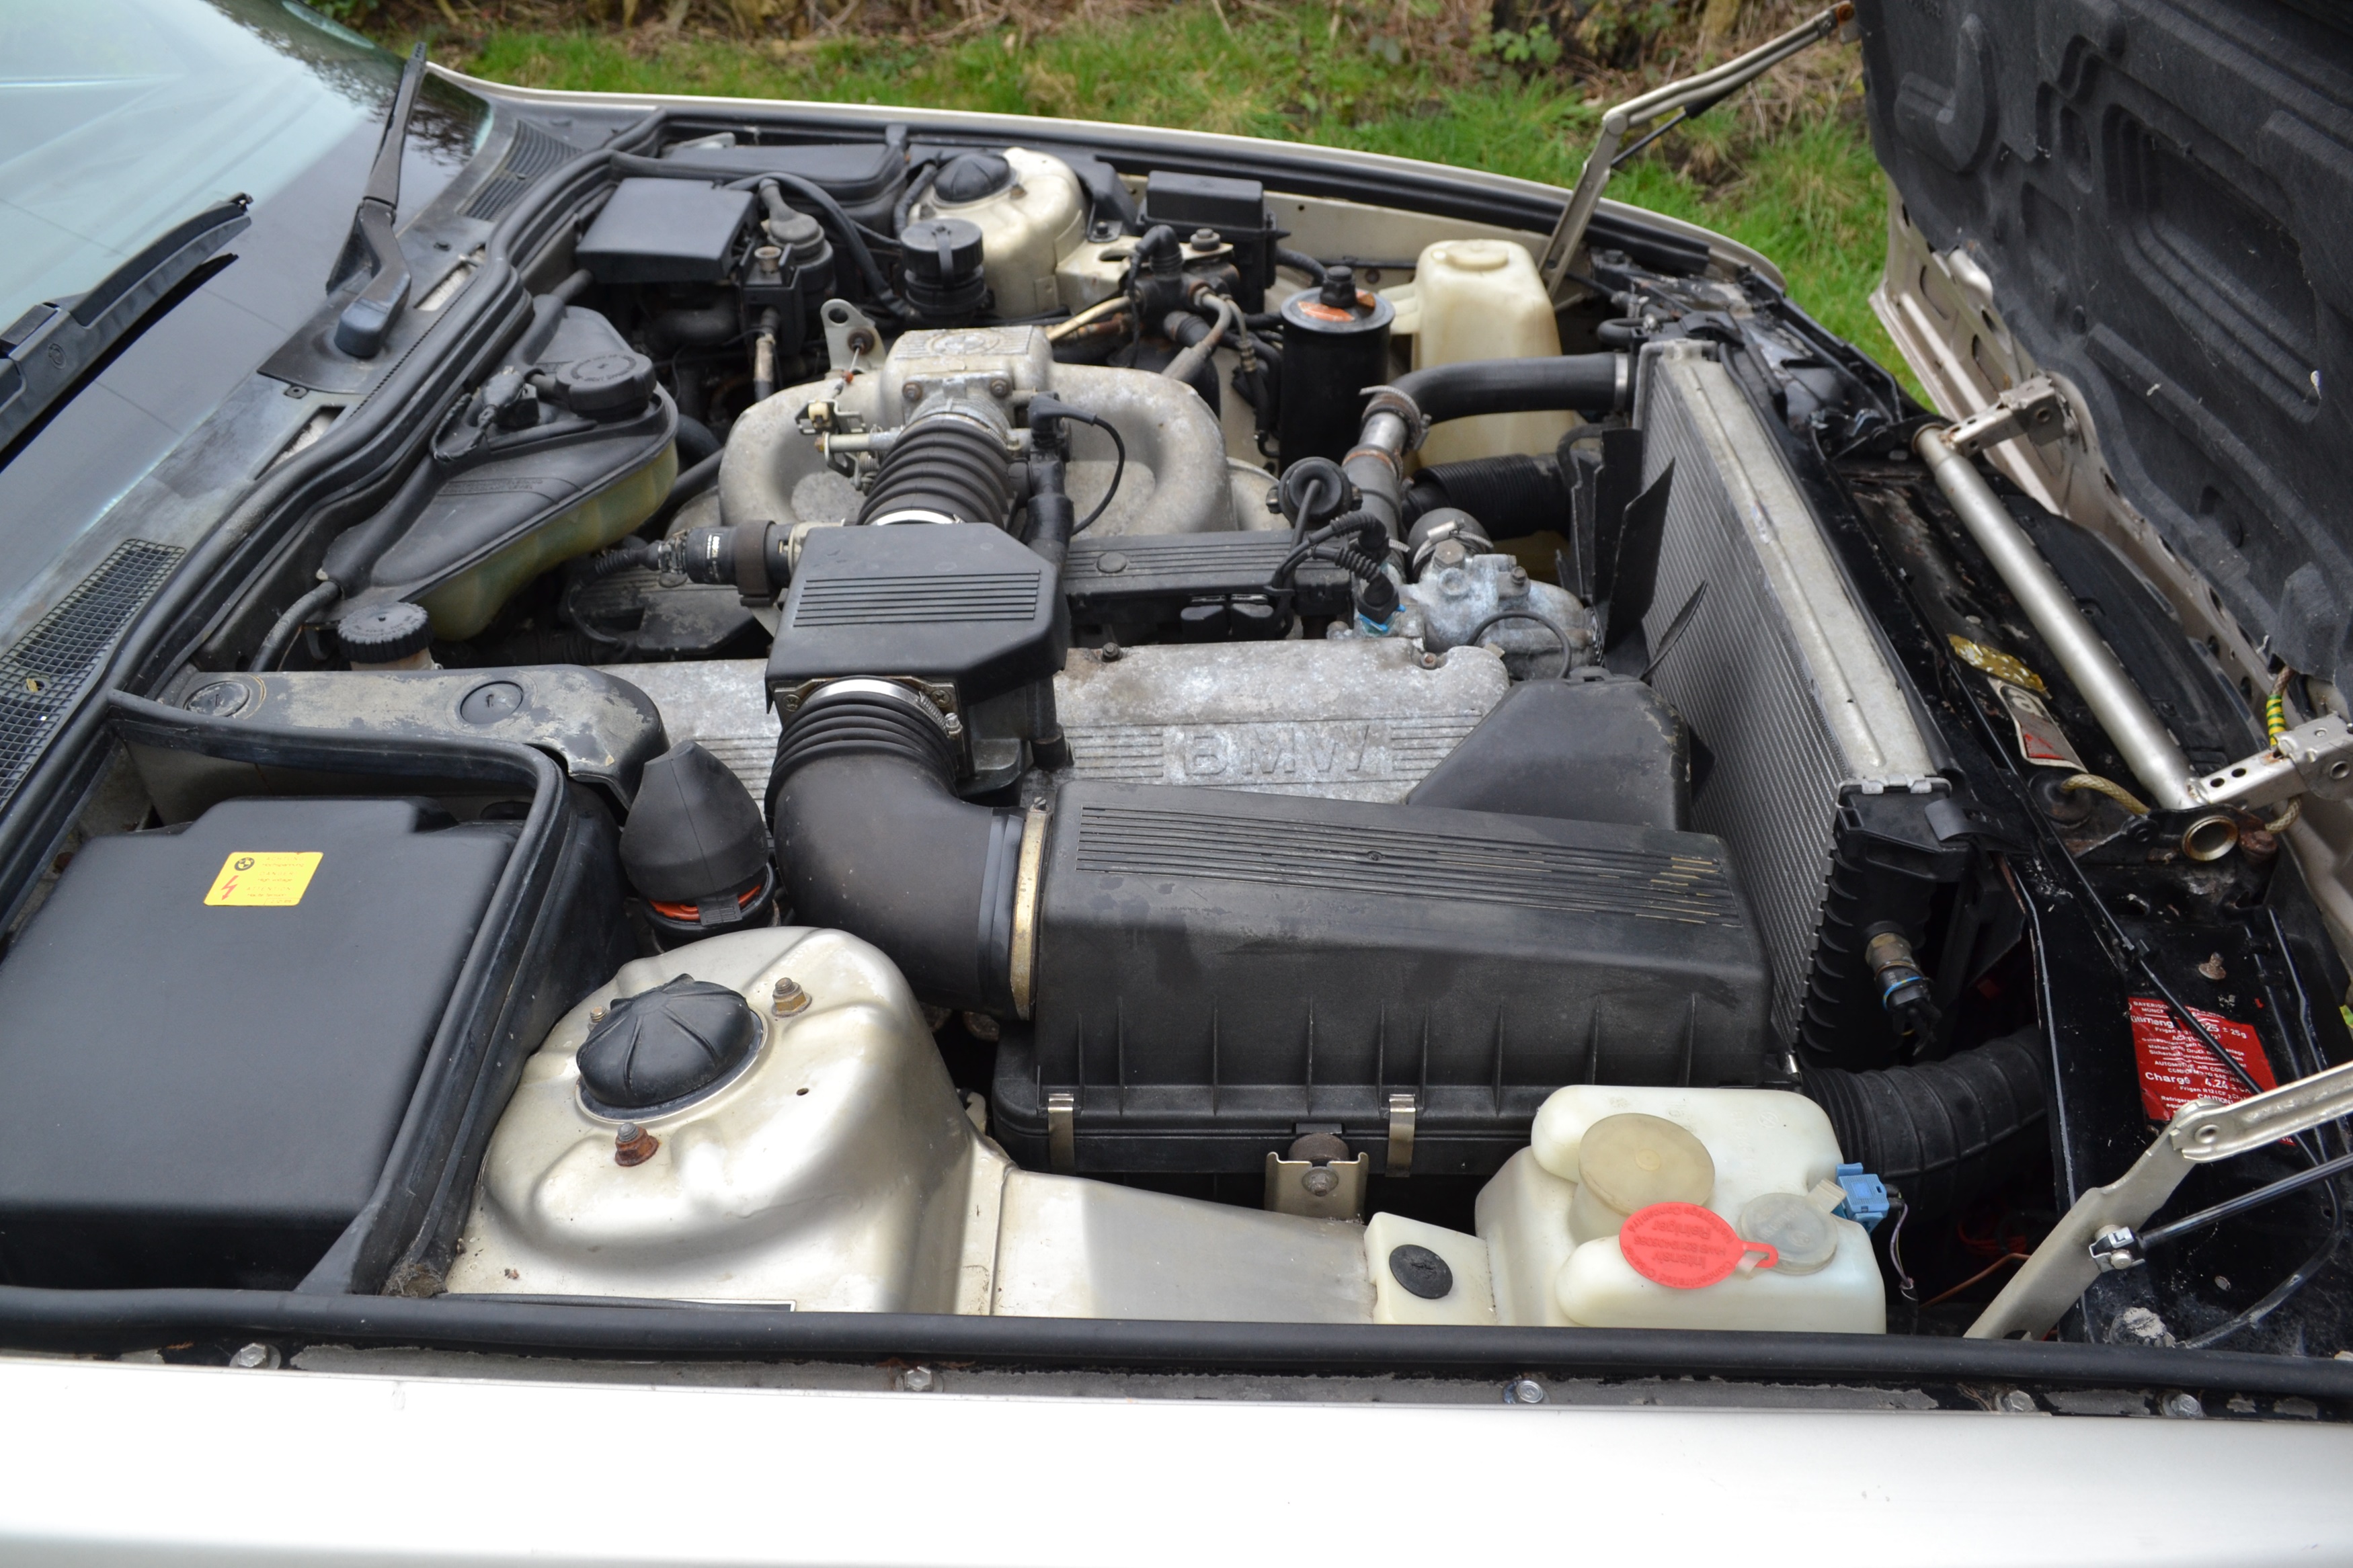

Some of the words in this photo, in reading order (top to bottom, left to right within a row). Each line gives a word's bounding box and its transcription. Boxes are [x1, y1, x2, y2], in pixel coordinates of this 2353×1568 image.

[1183, 724, 1370, 776] BMW
[2145, 1071, 2191, 1085] Charge
[1652, 1220, 1711, 1240] Reiniger
[1652, 1251, 1706, 1269] Intensiv
